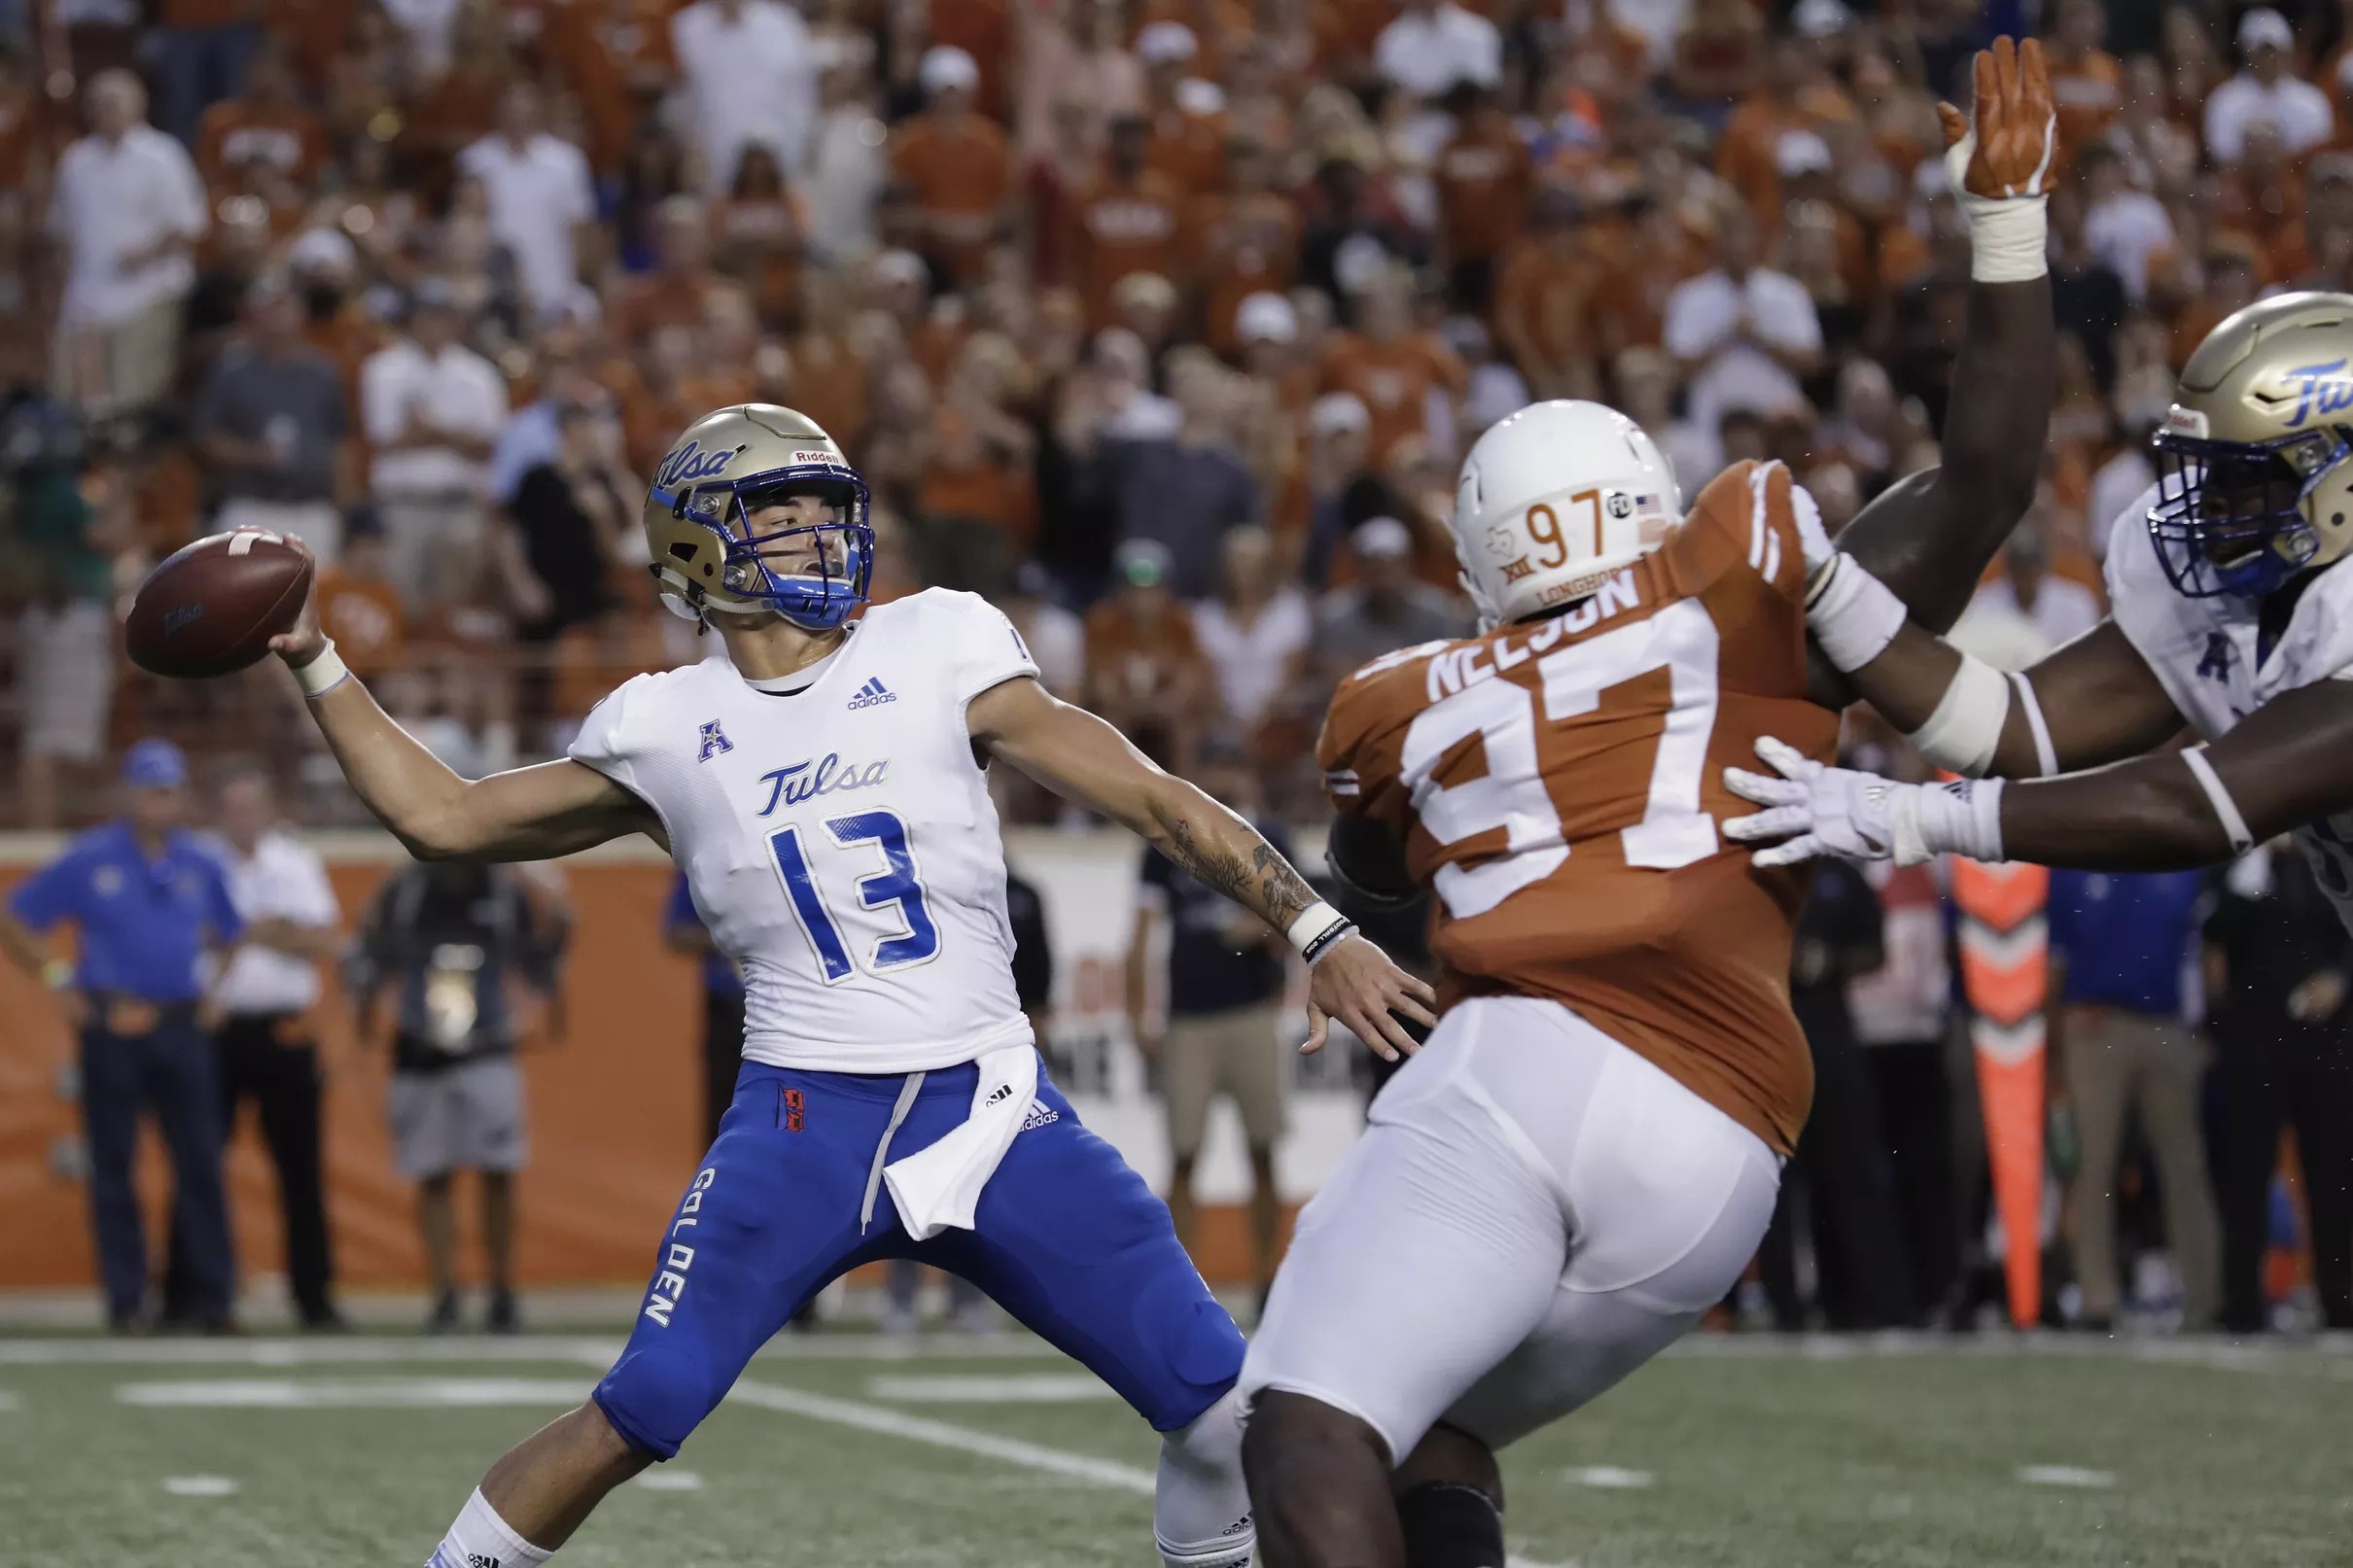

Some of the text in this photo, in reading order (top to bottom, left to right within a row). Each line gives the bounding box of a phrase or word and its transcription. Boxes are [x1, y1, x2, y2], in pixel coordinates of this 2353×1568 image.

[2281, 357, 2353, 428] Tu
[795, 452, 839, 465] Riddell
[1526, 488, 1602, 569] 97
[847, 691, 897, 711] adidas
[755, 751, 891, 818] Tulsa
[1400, 597, 1720, 920] 97
[764, 806, 941, 986] 13
[644, 1167, 716, 1329] GOLDEN
